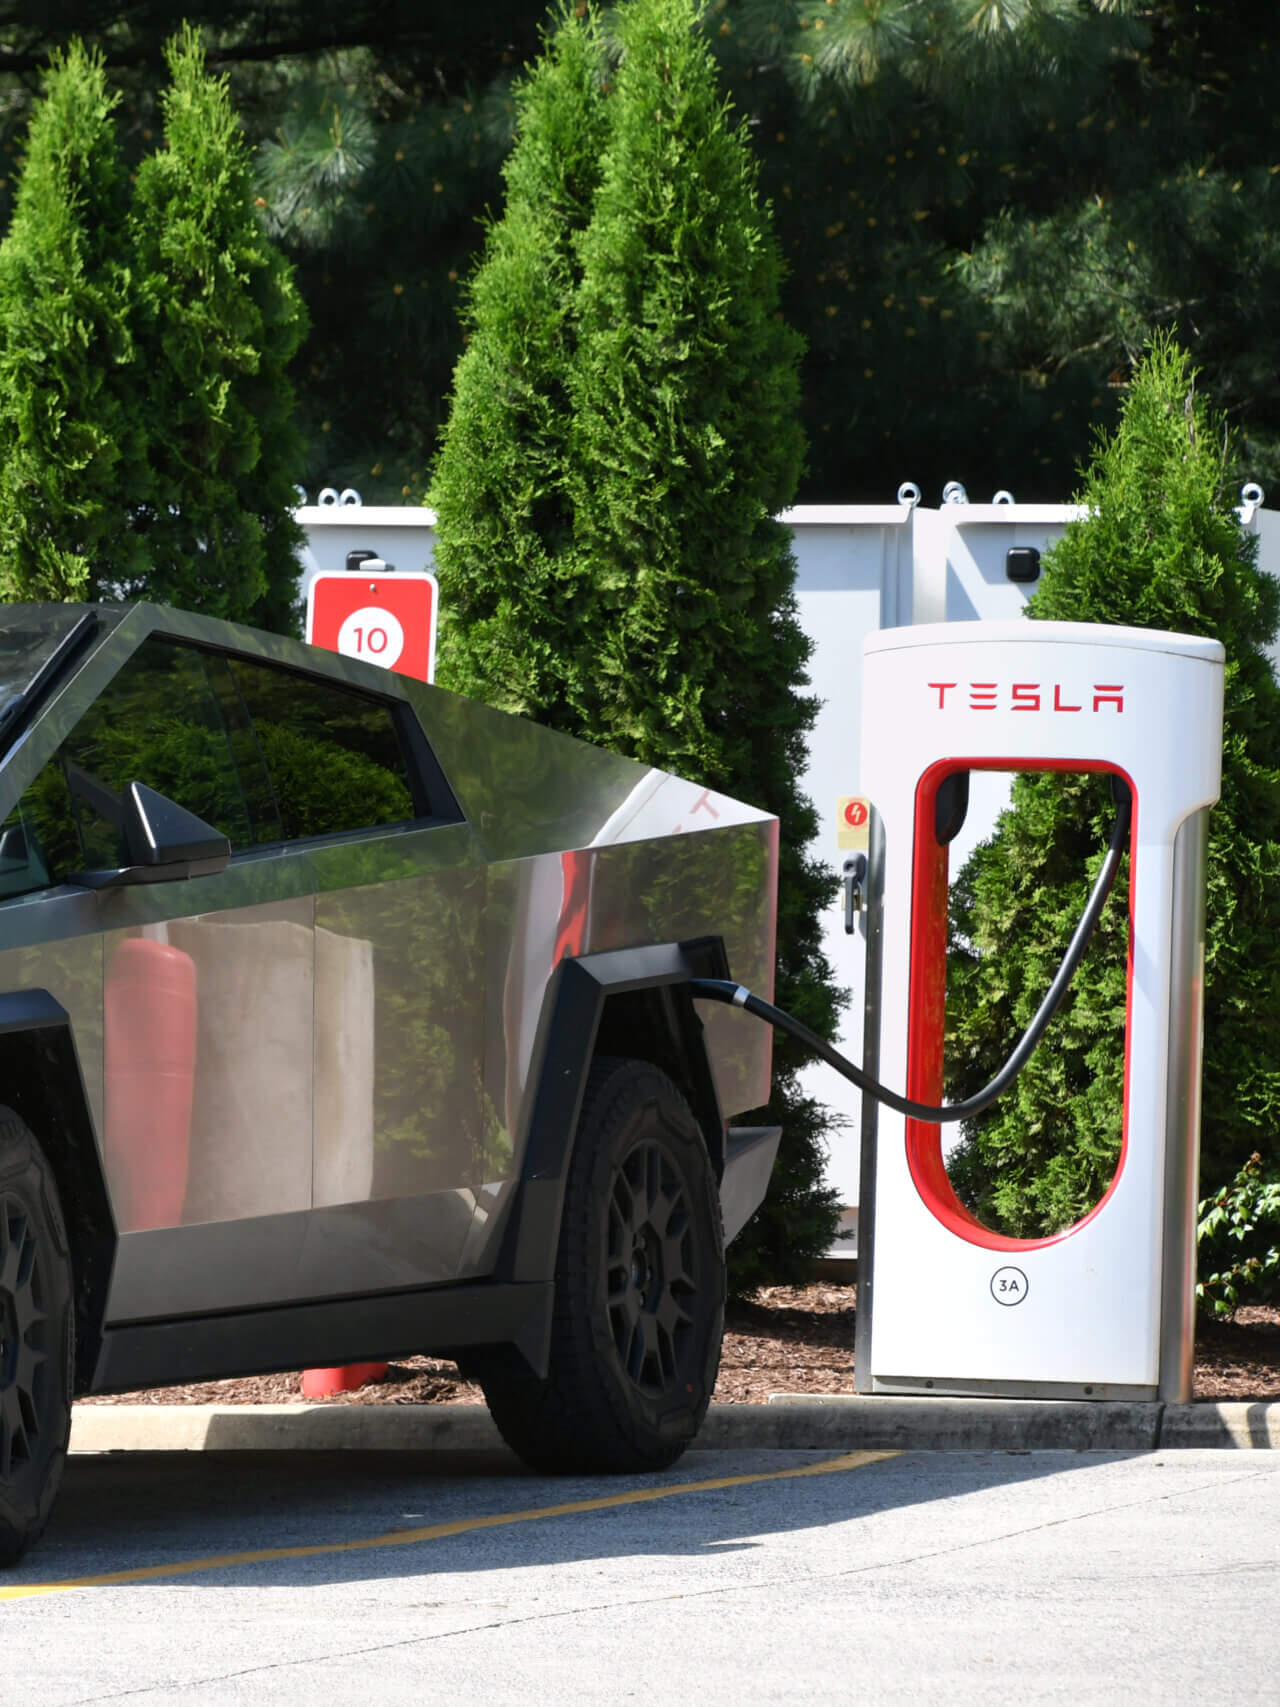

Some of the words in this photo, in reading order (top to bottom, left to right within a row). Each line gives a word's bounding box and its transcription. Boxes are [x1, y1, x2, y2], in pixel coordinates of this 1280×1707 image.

[353, 627, 388, 654] 10
[927, 682, 1125, 713] TESLA
[999, 1279, 1020, 1292] 3A
